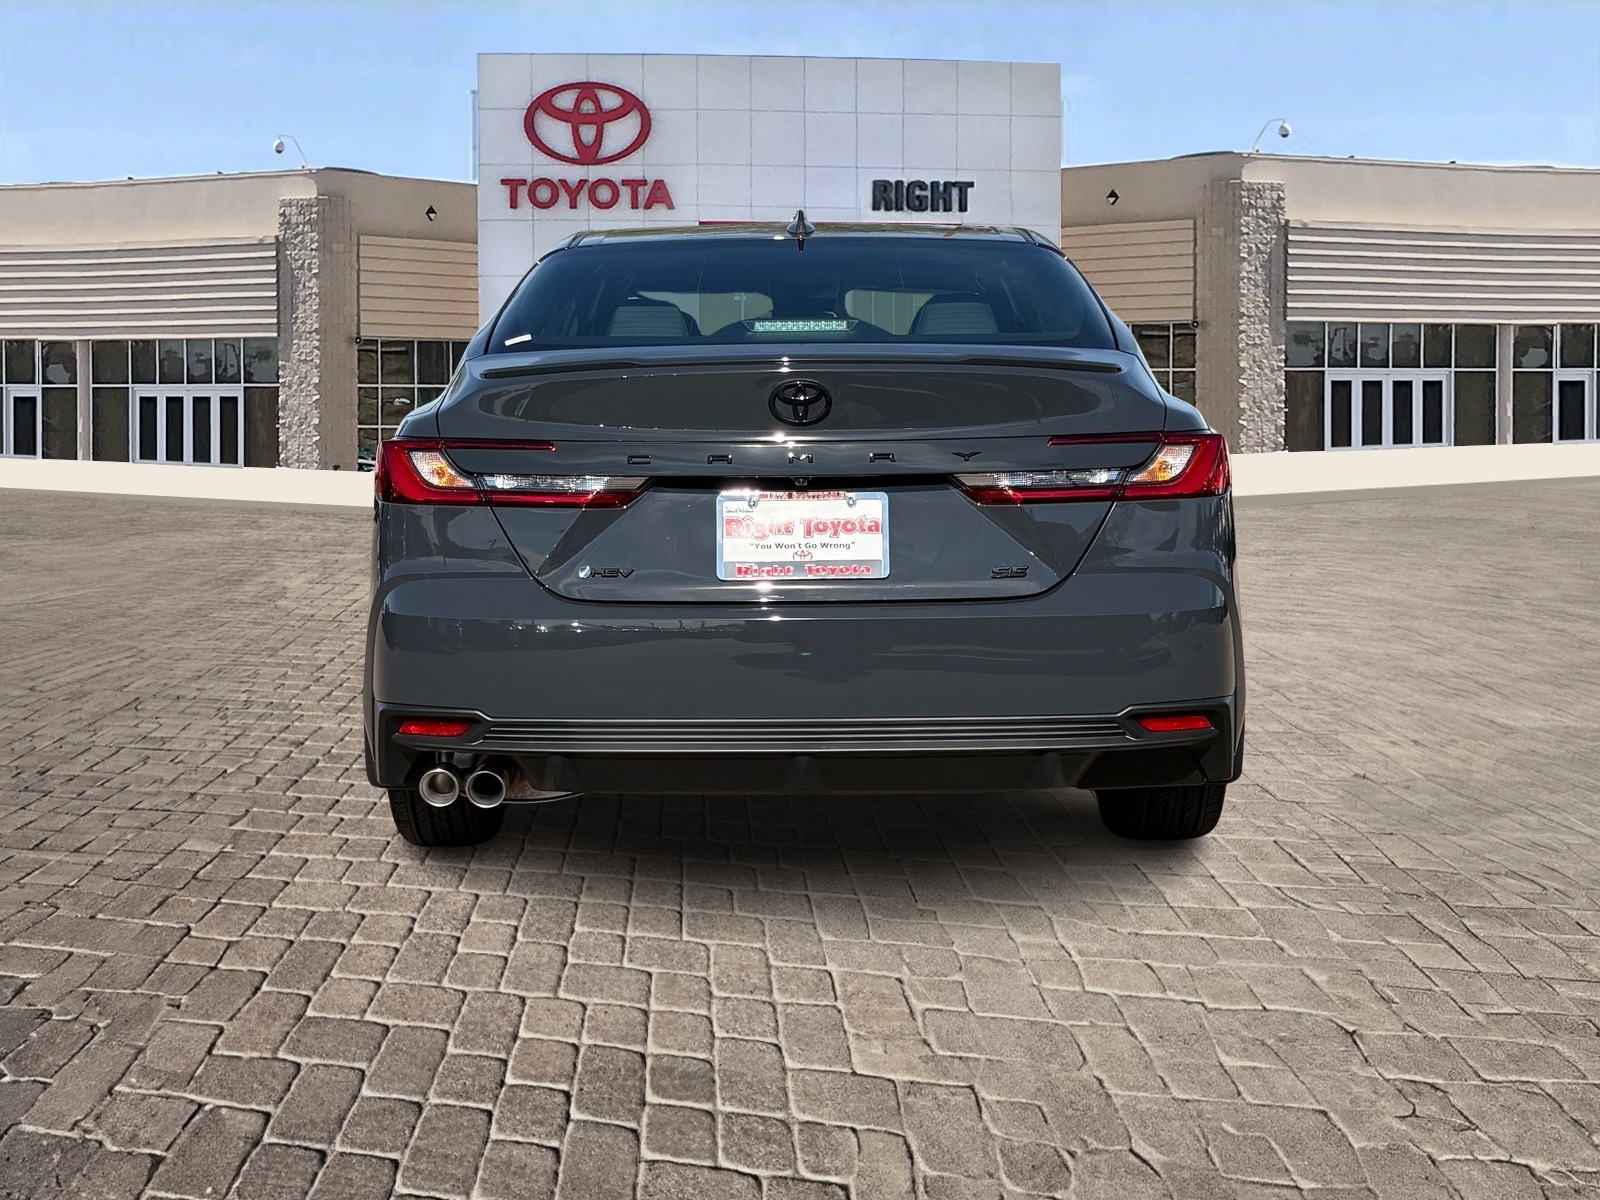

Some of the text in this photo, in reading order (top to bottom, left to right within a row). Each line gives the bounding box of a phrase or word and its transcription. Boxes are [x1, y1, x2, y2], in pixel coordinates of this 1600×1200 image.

[500, 177, 675, 210] TOYOTA
[870, 179, 975, 214] RIGHT
[627, 451, 982, 465] CAMRY
[724, 515, 882, 541] Right Toyota
[775, 542, 802, 550] Won't
[591, 567, 635, 578] HEV
[736, 563, 872, 577] Right Toyota
[990, 566, 1029, 579] SE
